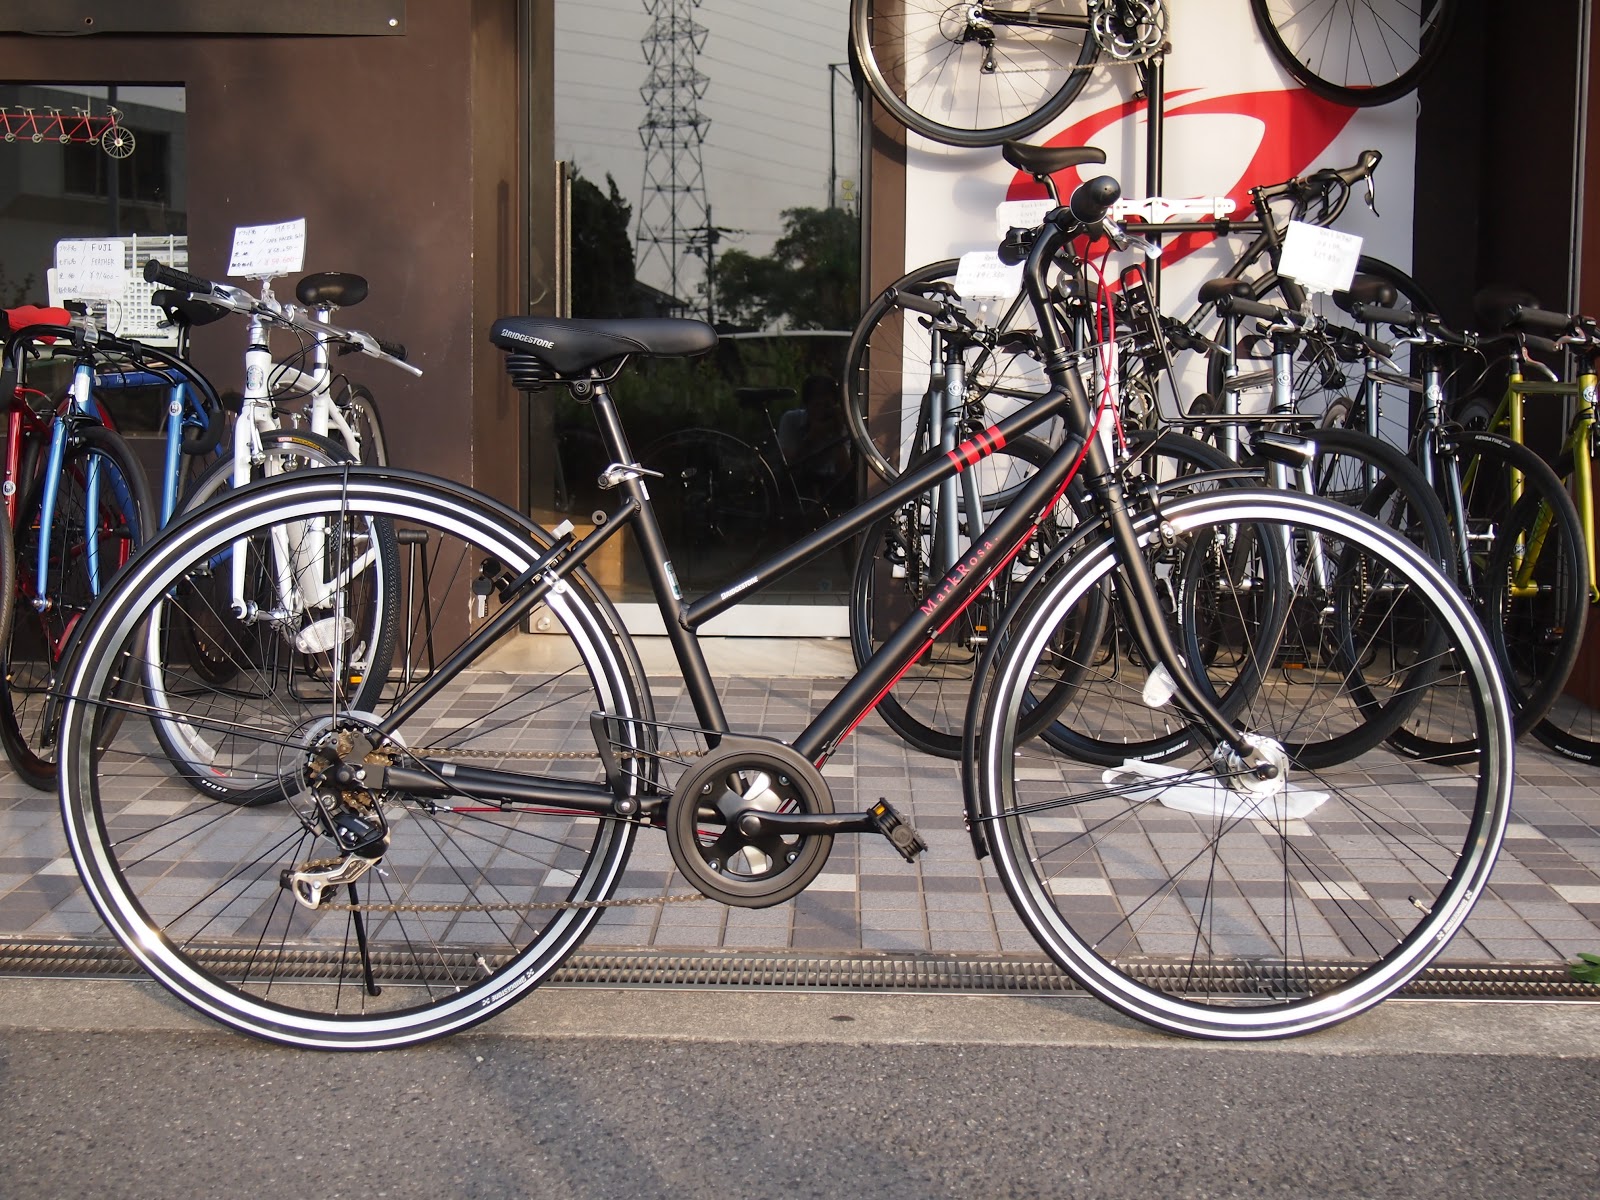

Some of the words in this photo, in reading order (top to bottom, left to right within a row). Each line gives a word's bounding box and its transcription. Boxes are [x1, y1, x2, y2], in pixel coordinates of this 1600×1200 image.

[91, 243, 112, 252] FUJI
[500, 328, 555, 350] BRIDGESTONE
[720, 575, 759, 601] BRIDGESTONE
[201, 779, 228, 793] KENDA
[491, 975, 526, 1002] BRIDGESTONE
